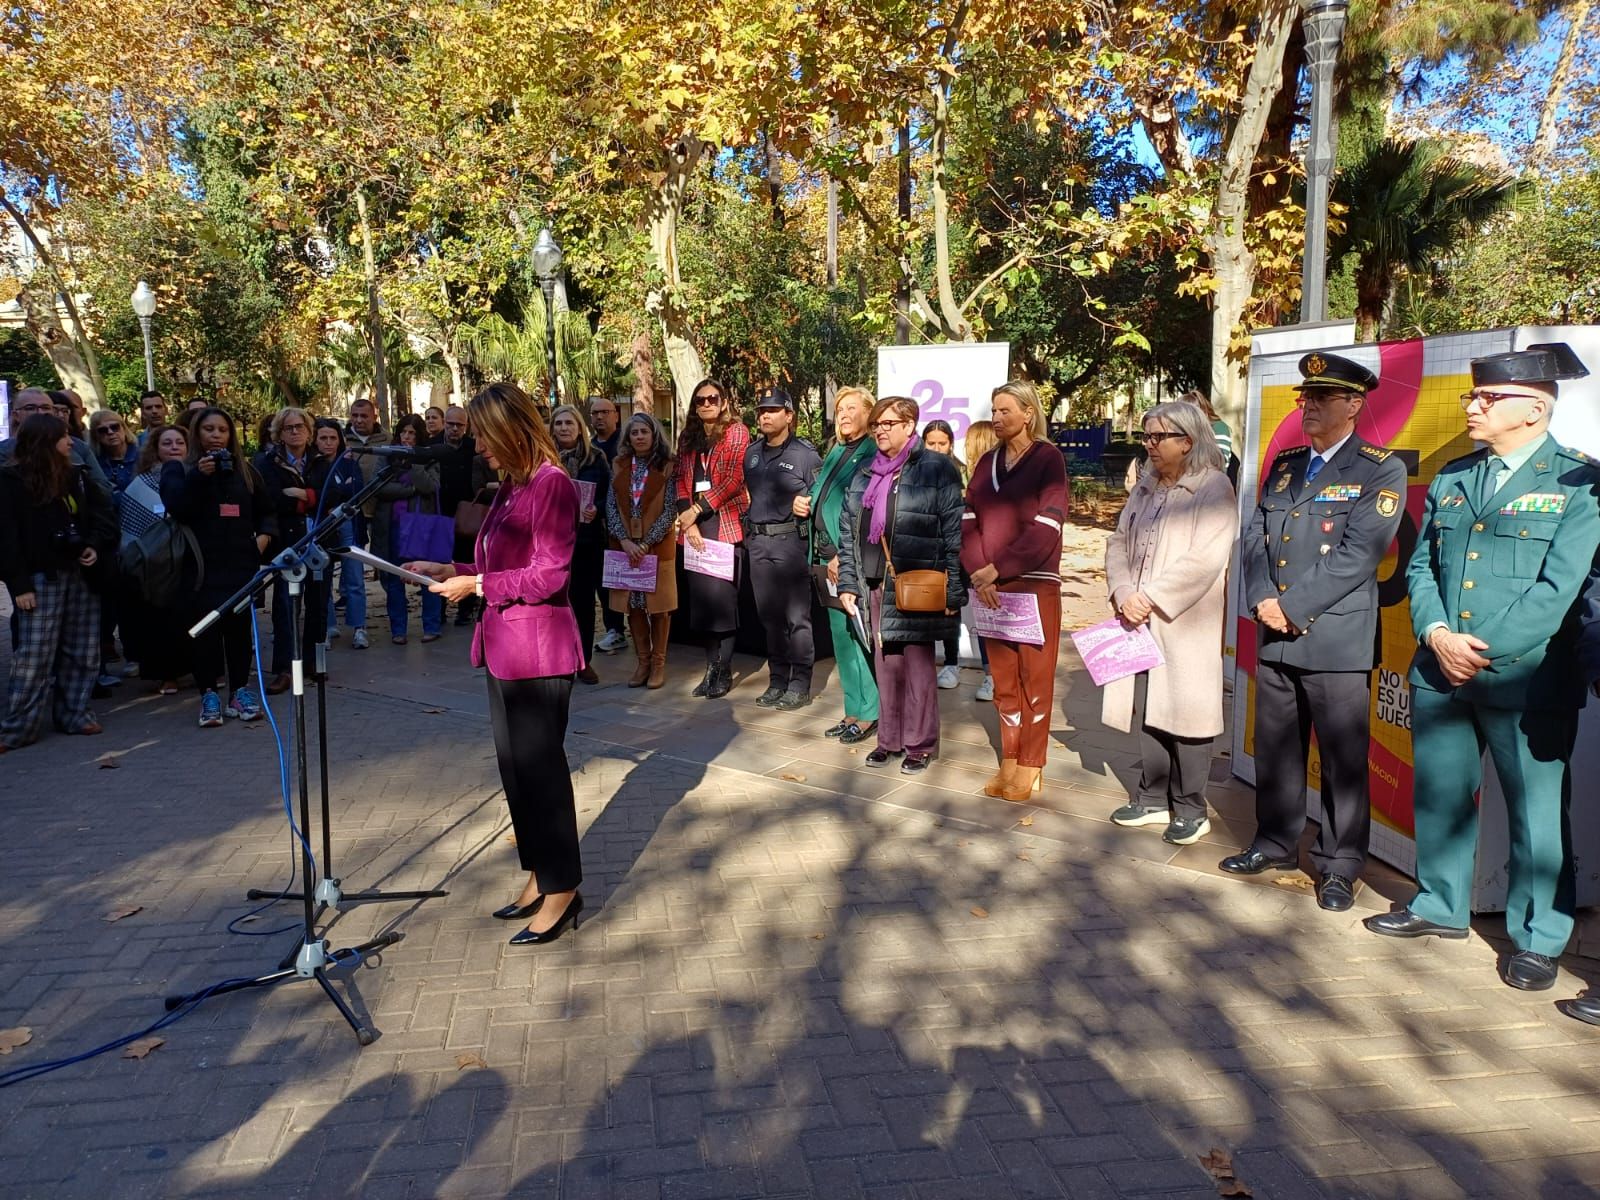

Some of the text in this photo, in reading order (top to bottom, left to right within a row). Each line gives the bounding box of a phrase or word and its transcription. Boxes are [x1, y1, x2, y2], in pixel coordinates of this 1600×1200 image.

[911, 379, 971, 441] 25
[1379, 668, 1400, 688] NO
[1378, 685, 1408, 710] ES U
[1377, 705, 1411, 730] JUEG
[1367, 757, 1398, 789] NACION
